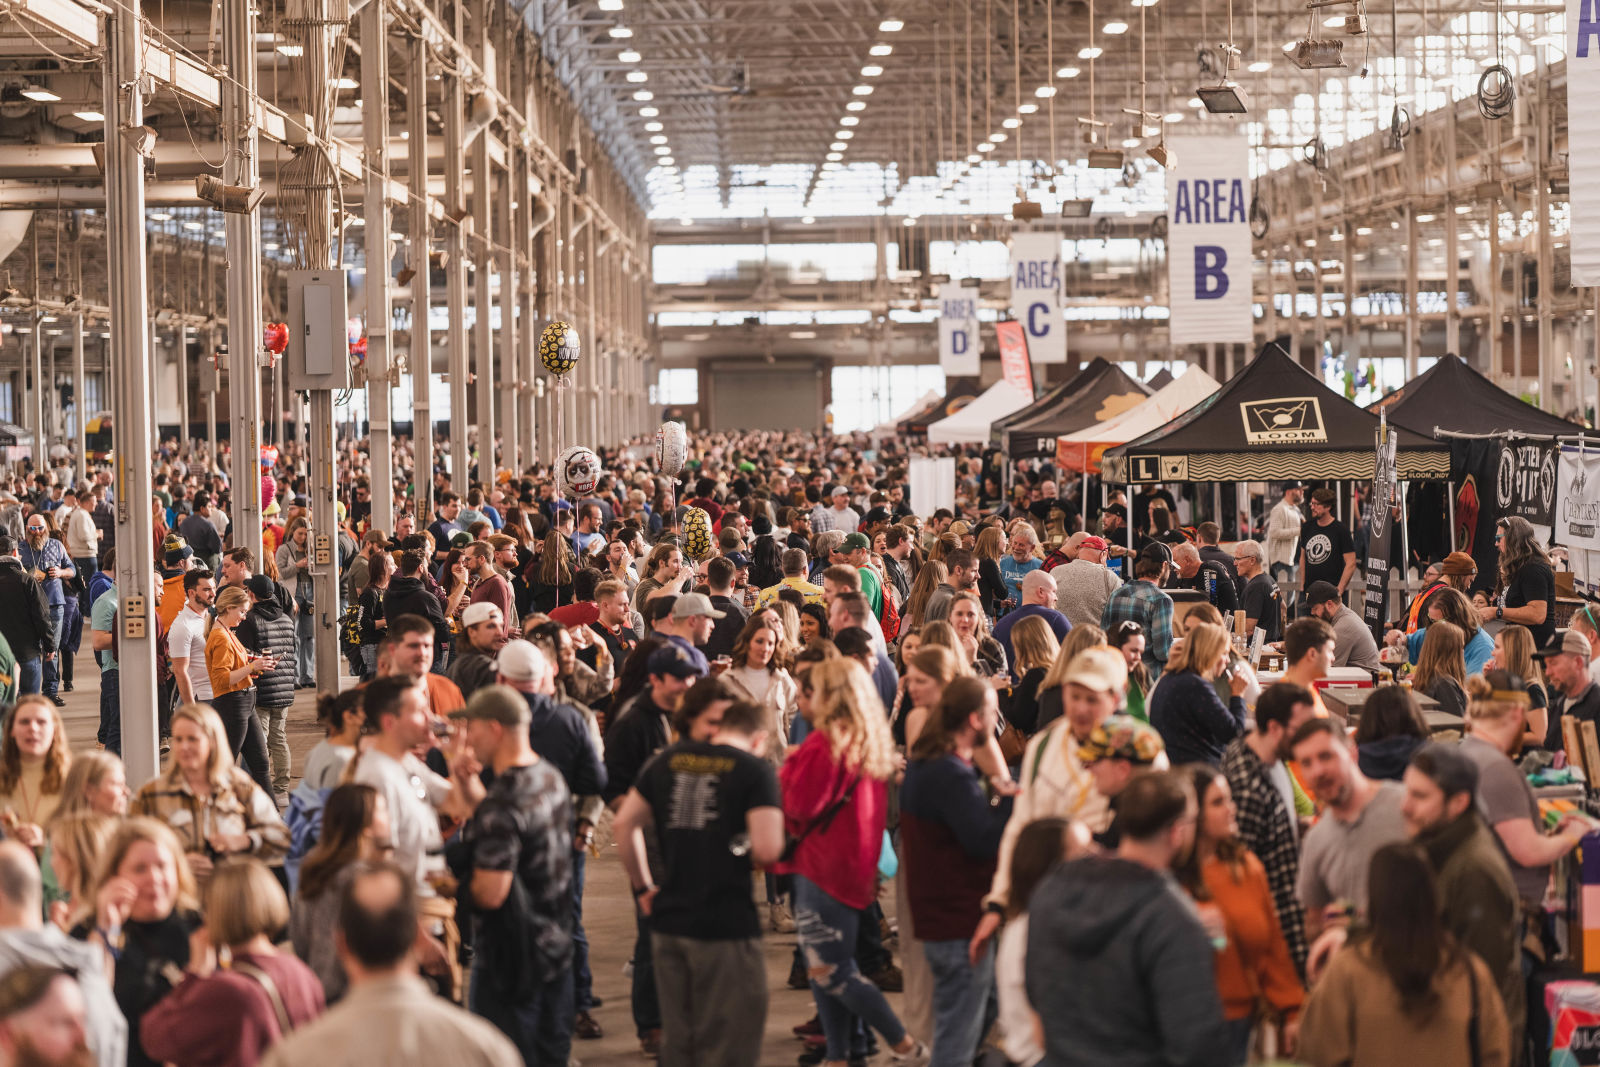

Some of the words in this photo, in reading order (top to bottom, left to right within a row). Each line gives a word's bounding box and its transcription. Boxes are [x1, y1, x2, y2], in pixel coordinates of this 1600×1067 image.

[1174, 179, 1246, 224] AREA
[1015, 261, 1061, 289] AREA
[1194, 245, 1229, 300] B
[943, 300, 975, 319] AREA
[1028, 302, 1050, 338] C
[952, 330, 968, 354] D
[1258, 431, 1315, 440] LOOM
[1139, 459, 1152, 479] L
